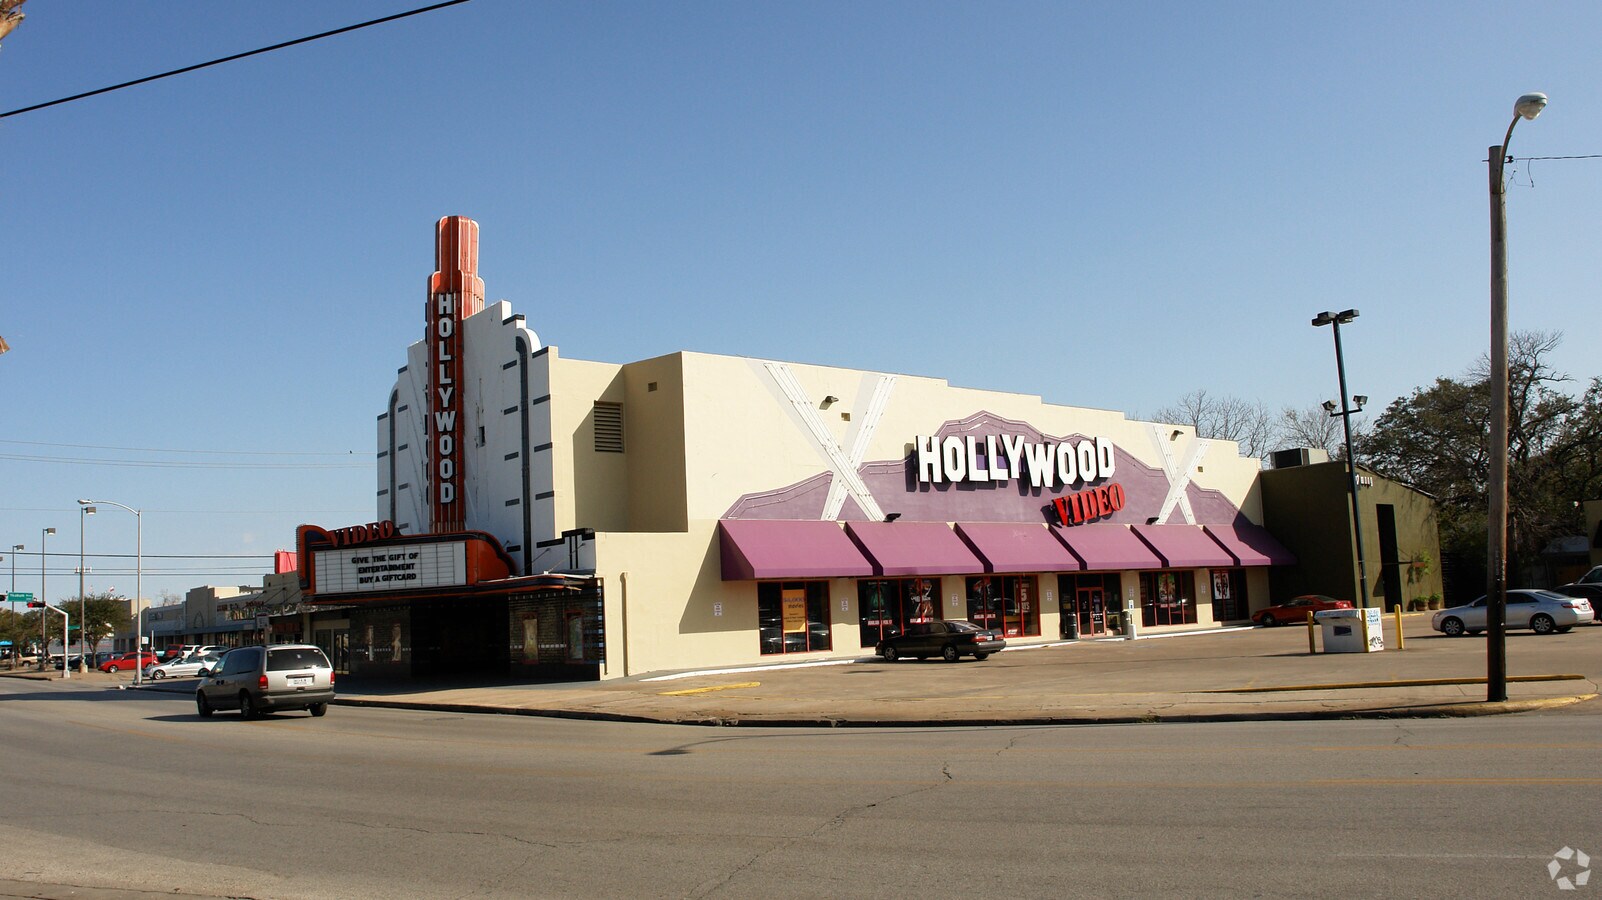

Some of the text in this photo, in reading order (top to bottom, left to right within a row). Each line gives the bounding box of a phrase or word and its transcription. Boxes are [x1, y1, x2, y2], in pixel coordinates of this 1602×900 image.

[434, 293, 456, 504] HOLLYWOOD
[916, 433, 1116, 488] HOLLYWOOD
[1052, 482, 1126, 527] VIDEO
[327, 519, 395, 548] VIDEO
[351, 552, 419, 564] GIVE THE GIFT OF
[358, 562, 416, 574] ENTERTAINMENT
[359, 572, 417, 584] BUY A GIFTCARD
